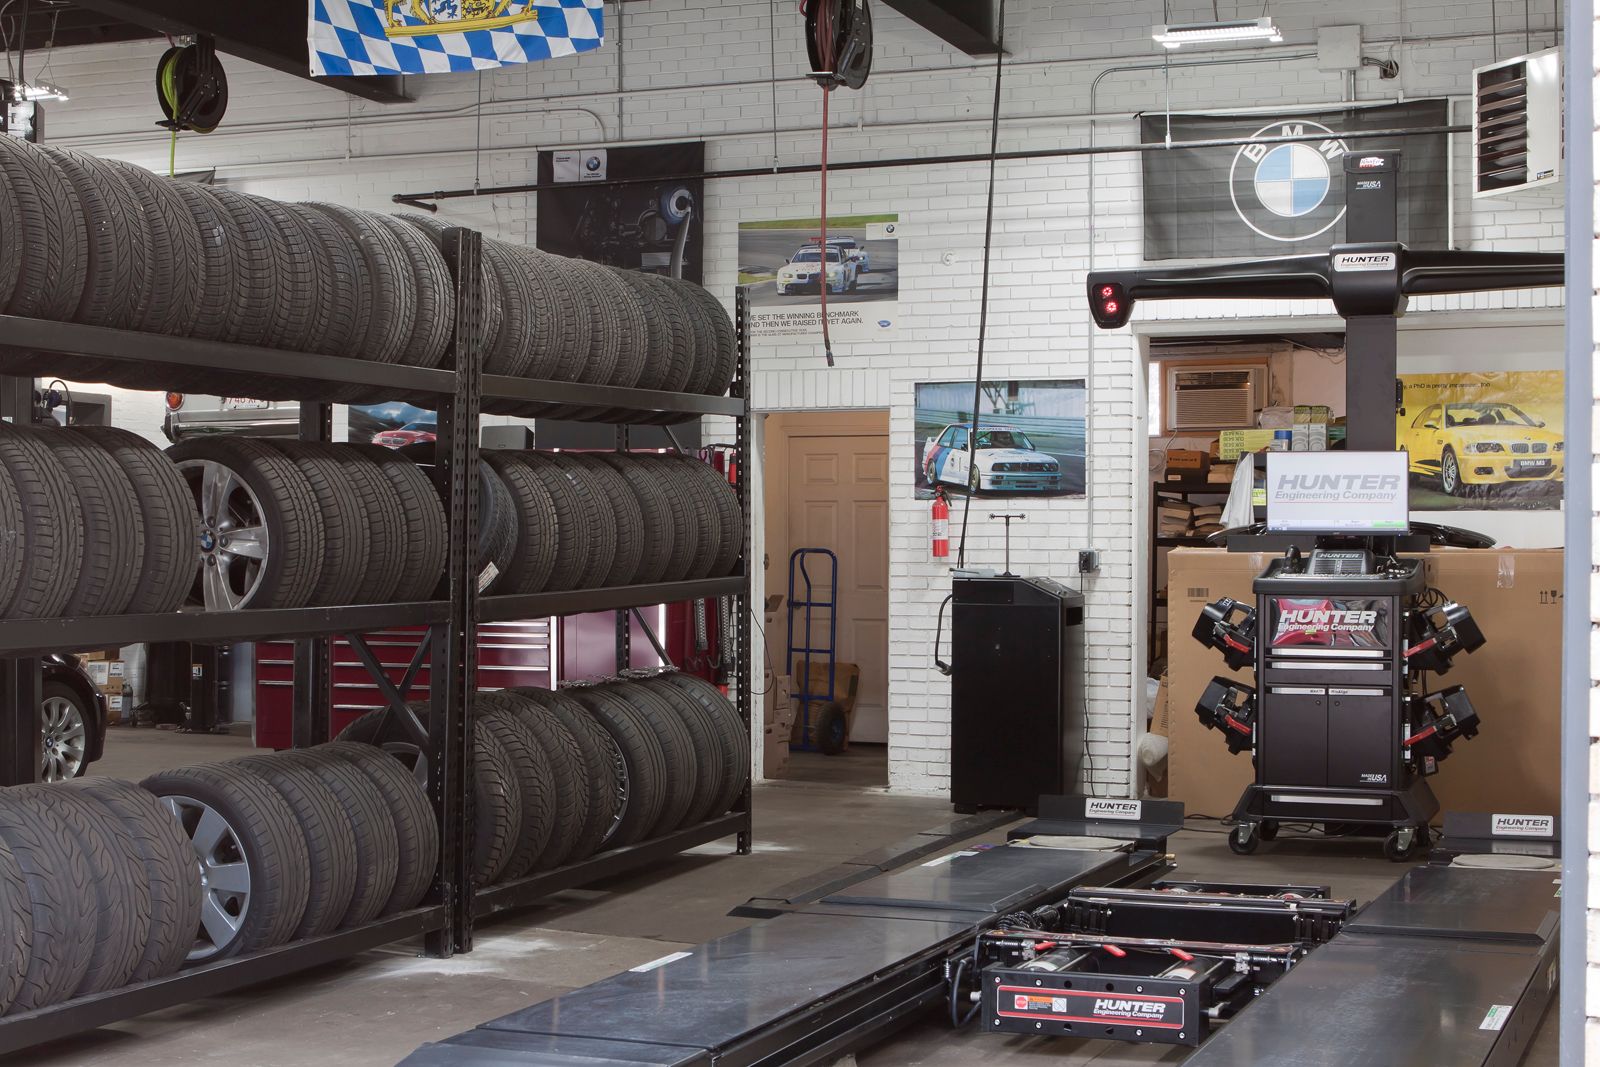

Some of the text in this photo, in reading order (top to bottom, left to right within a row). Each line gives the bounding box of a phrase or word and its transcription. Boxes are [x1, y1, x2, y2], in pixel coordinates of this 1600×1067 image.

[1342, 255, 1390, 263] HUNTER
[786, 312, 815, 320] WINNING
[816, 311, 859, 319] BNCHMARK
[762, 320, 779, 328] THEN
[793, 319, 817, 327] RAISED
[1277, 474, 1400, 490] HUNTER
[1274, 490, 1397, 501] Engineering Company
[1279, 609, 1377, 624] HUNTER
[1277, 622, 1375, 632] Engineering Company
[1371, 774, 1387, 783] USA
[1090, 802, 1138, 811] HUNTER
[1497, 818, 1550, 827] HUNTER
[1095, 998, 1166, 1014] HUNTER
[1093, 1008, 1164, 1020] Engineering Company
